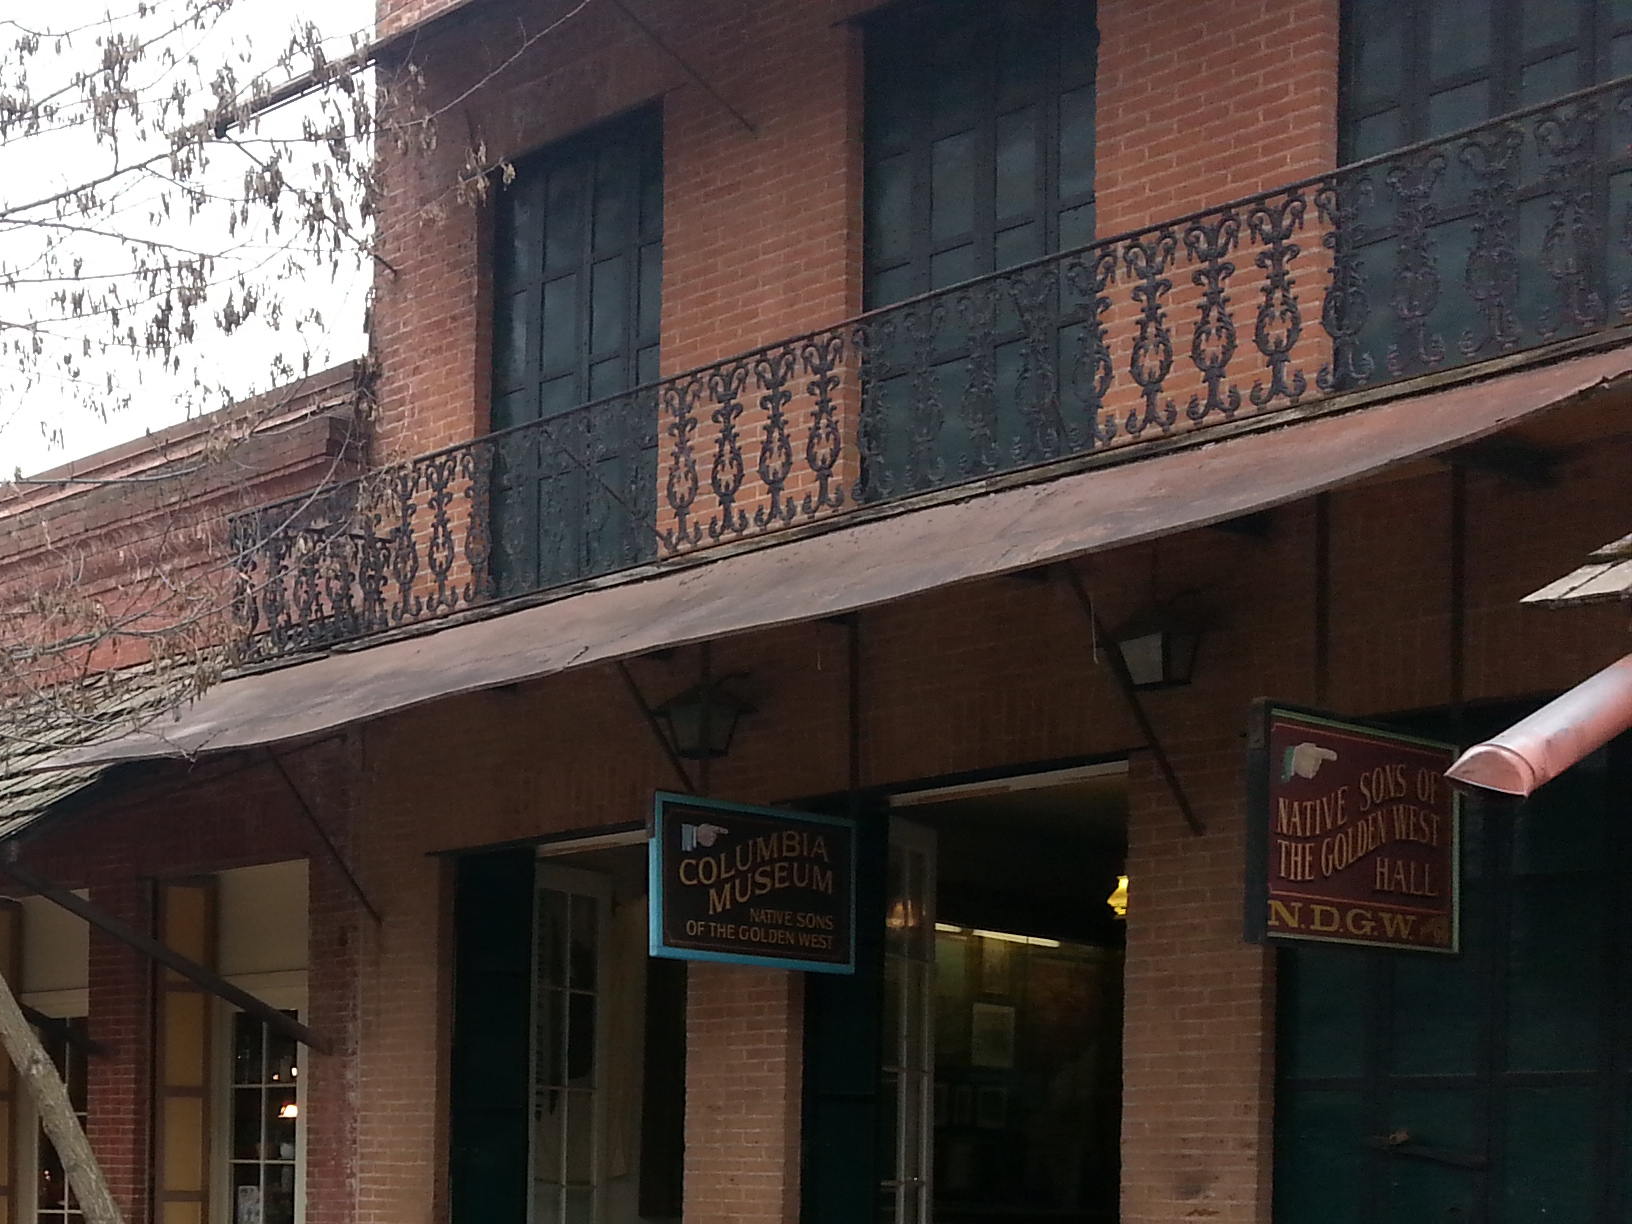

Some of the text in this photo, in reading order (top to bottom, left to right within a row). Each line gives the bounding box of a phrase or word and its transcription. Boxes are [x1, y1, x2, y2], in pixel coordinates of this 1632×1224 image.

[1276, 764, 1439, 836] NATIVE SONS OF
[679, 830, 829, 885] COLUMBIA
[1277, 804, 1440, 881] THE GOLDEN WEST
[709, 862, 833, 915] MUSEUM
[1376, 857, 1438, 896] HALL
[686, 920, 833, 949] OF THE GOLDEN WEST
[750, 908, 834, 930] NATIVE SONS
